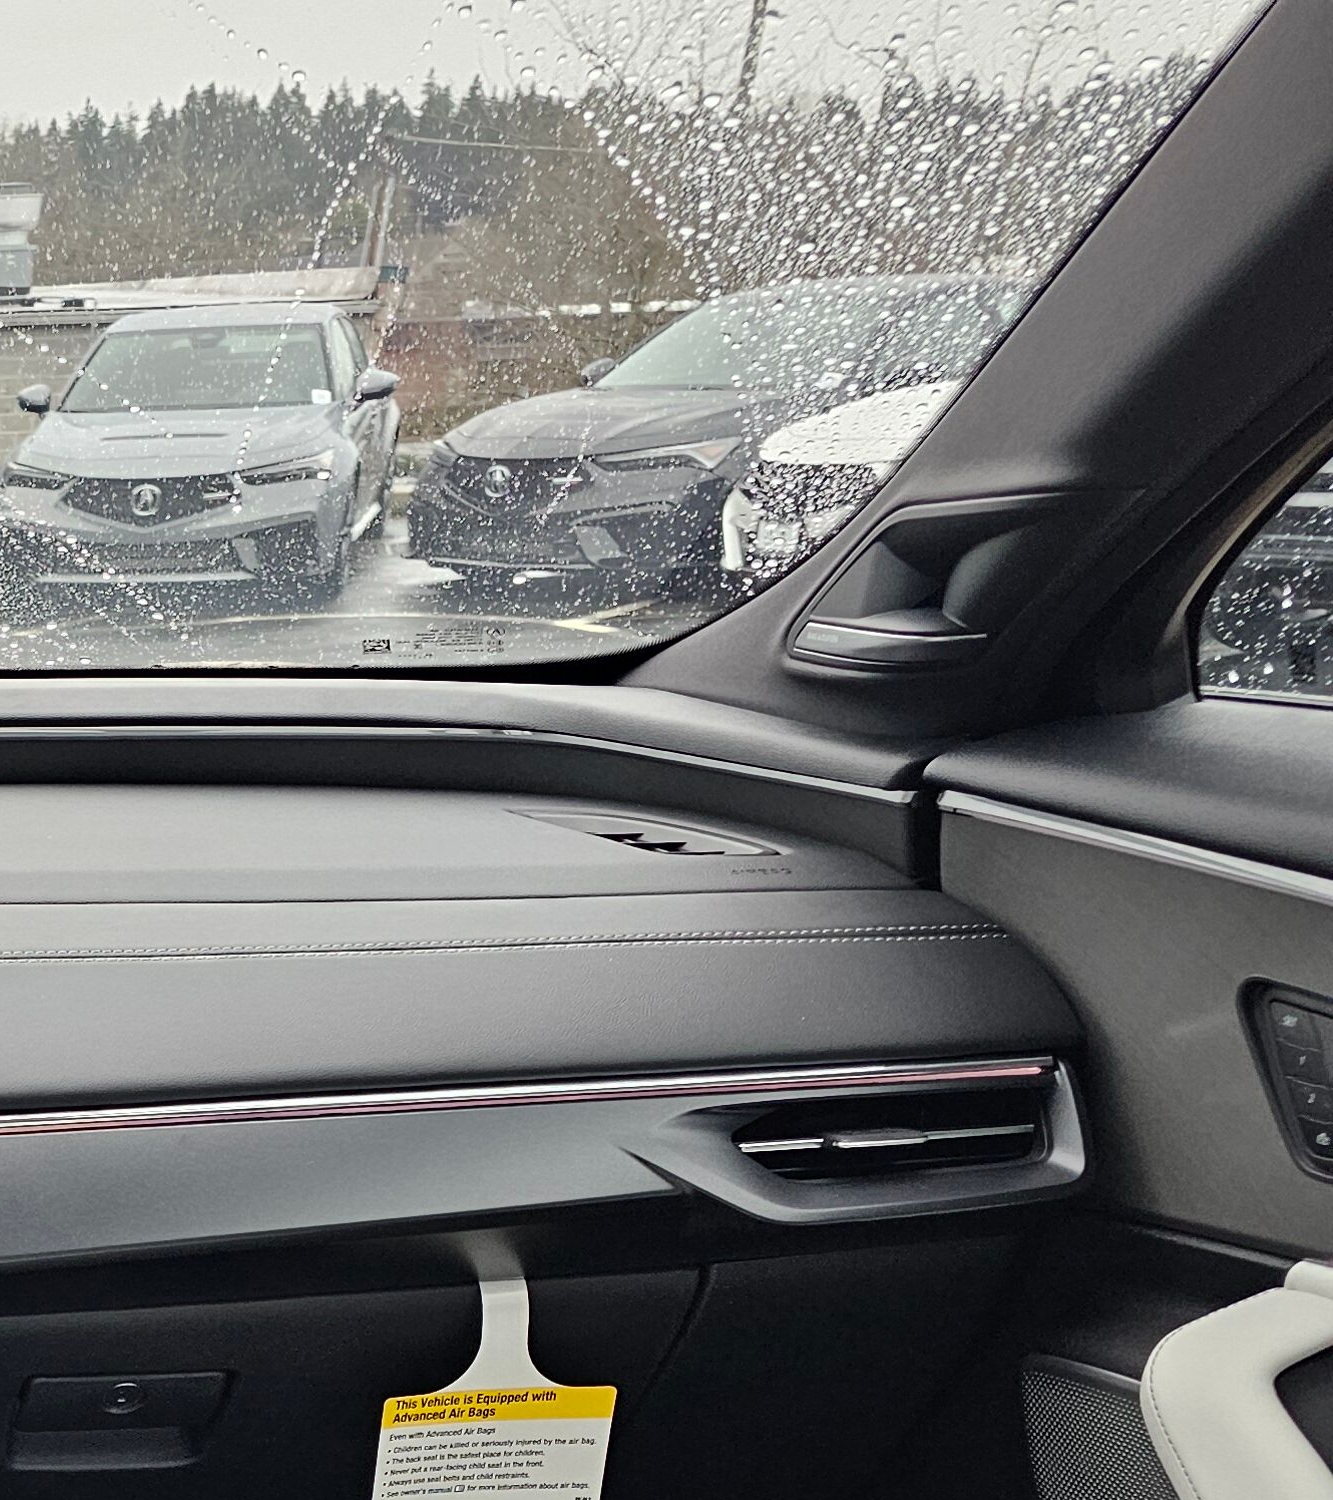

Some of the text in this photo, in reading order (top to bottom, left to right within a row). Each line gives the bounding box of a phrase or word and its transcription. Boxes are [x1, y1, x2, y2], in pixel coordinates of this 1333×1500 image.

[396, 1390, 557, 1410] This Vehicle is Equipped with
[393, 1407, 496, 1424] Advanced Air Bags
[389, 1427, 496, 1442] Even with Advanced Air Bags
[393, 1445, 422, 1454] Children
[449, 1441, 470, 1449] killed
[481, 1438, 513, 1448] seriously
[516, 1438, 542, 1447] injured
[543, 1438, 554, 1447] by
[555, 1437, 567, 1445] the
[568, 1437, 579, 1445] air
[581, 1437, 597, 1446] bag.
[393, 1457, 405, 1465] The
[406, 1455, 422, 1463] back
[423, 1454, 438, 1462] seat
[447, 1452, 459, 1460] the
[460, 1451, 481, 1459] safest
[483, 1450, 502, 1459] place
[515, 1449, 545, 1457] children.
